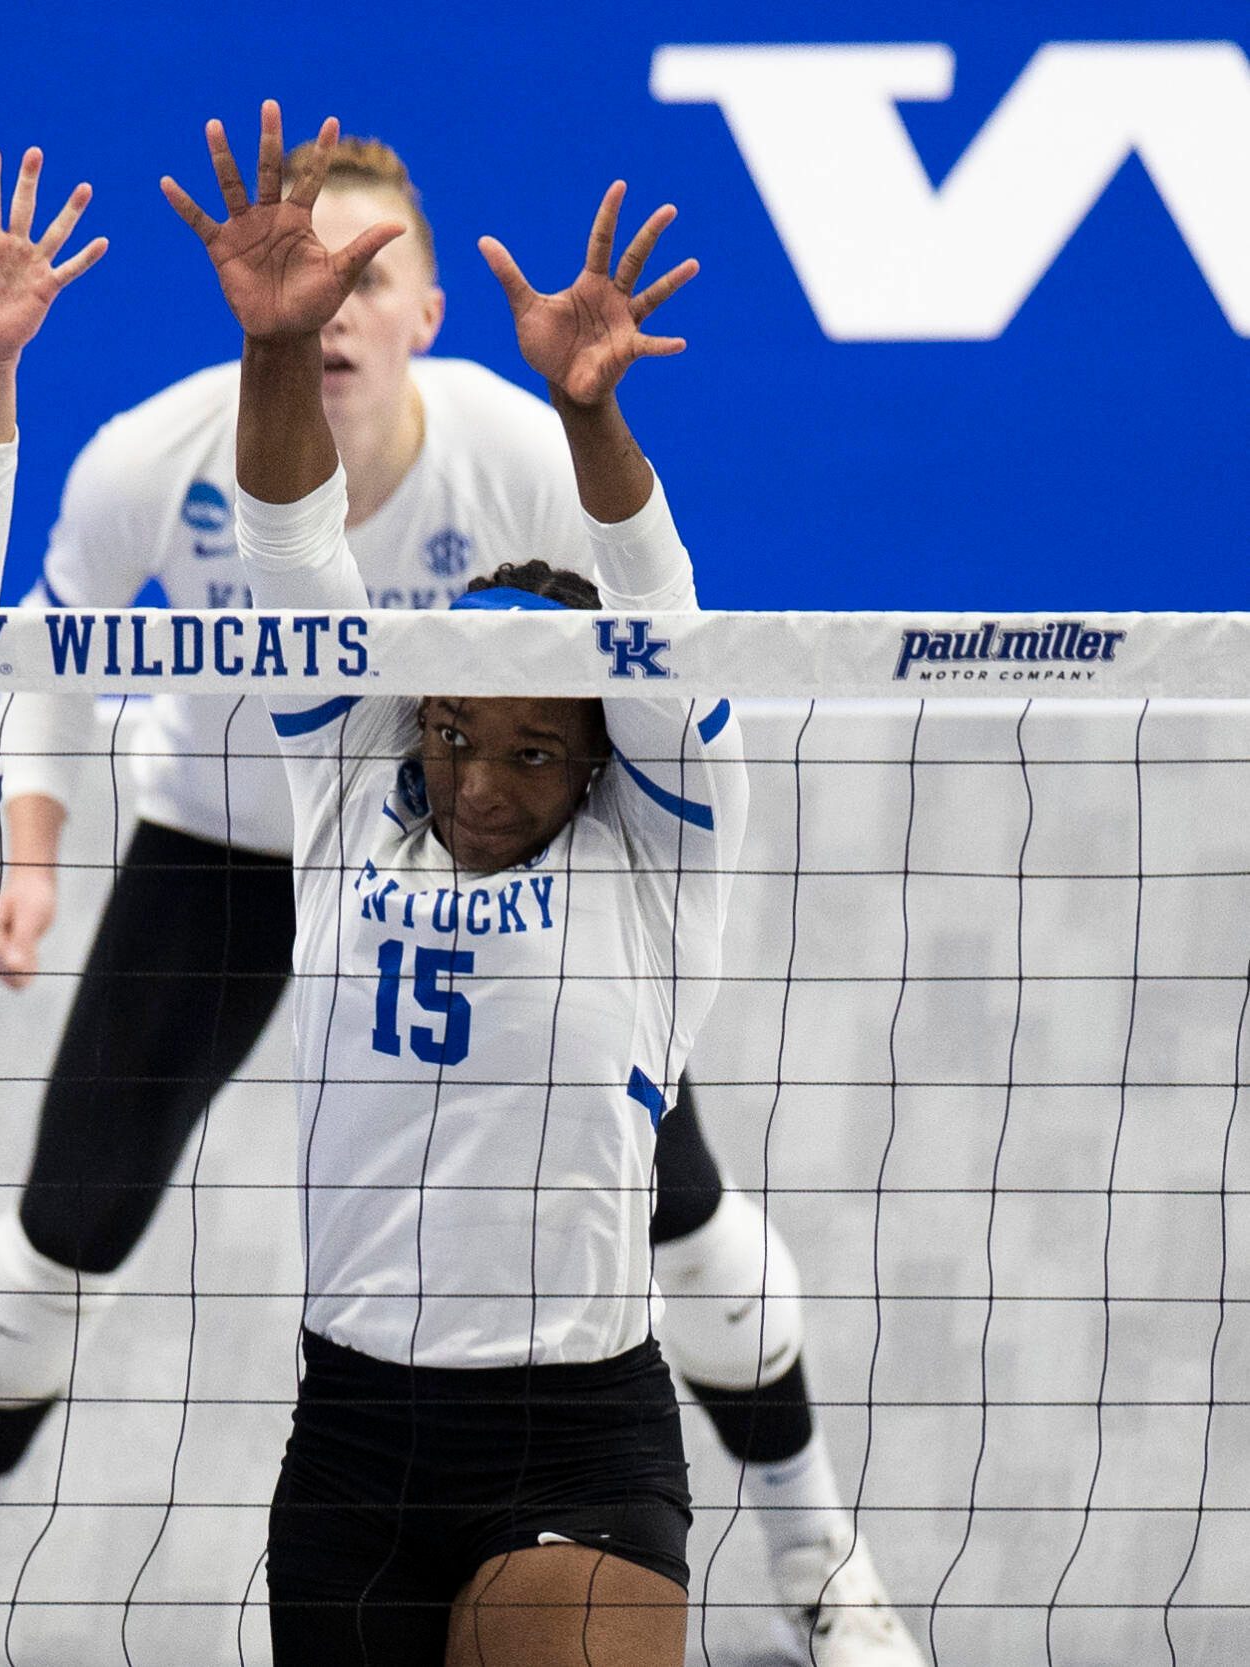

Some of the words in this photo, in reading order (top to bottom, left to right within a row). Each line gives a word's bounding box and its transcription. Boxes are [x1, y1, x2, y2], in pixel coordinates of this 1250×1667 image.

[45, 614, 369, 677] WILDCATS
[592, 617, 671, 679] UK
[893, 620, 1000, 681] paul
[997, 620, 1128, 662] miller
[920, 670, 989, 681] MOTOR
[999, 671, 1096, 681] COMPANY
[372, 938, 475, 1066] 15
